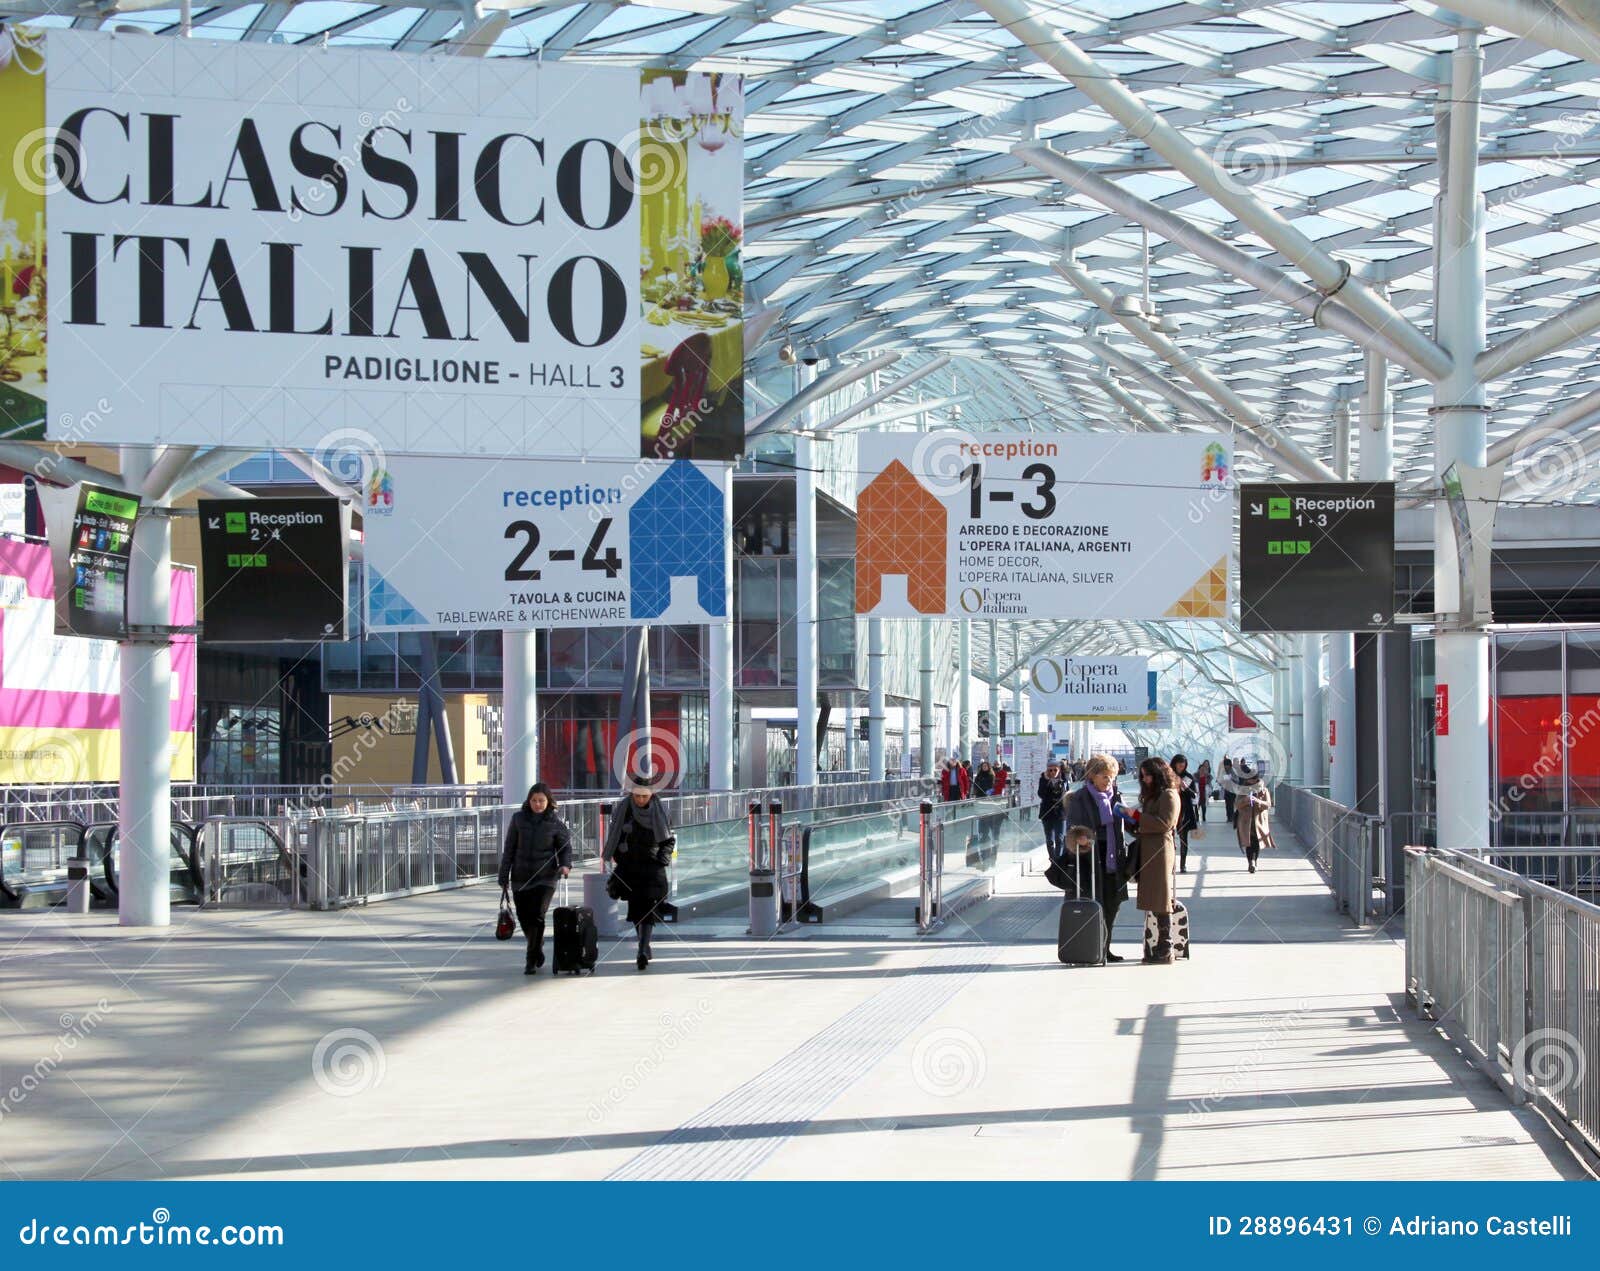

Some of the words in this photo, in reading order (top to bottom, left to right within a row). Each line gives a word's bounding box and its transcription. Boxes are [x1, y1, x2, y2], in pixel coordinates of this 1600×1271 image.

[54, 106, 635, 231] CLASSICO
[63, 231, 628, 348] ITALIANO
[324, 355, 500, 384] PADIGLIONE
[529, 365, 600, 388] HALL
[609, 366, 625, 389] 3
[960, 440, 1057, 460] reception
[503, 484, 621, 510] reception
[960, 463, 1057, 520] 1-3
[1295, 497, 1375, 513] Reception
[250, 512, 323, 526] Reception
[960, 526, 1009, 537] ARREDO
[1013, 526, 1021, 536] E
[1024, 525, 1109, 537] DECORAZIONE
[504, 518, 622, 581] 2-4
[960, 541, 1011, 552] L'OPERA
[1015, 541, 1074, 554] ITALIANA,
[1078, 541, 1131, 553] ARGENTI
[960, 556, 995, 567] HOME
[998, 556, 1043, 569] DECOR,
[960, 571, 1008, 583] L'OPERA
[1012, 572, 1069, 585] ITALIANA,
[1073, 572, 1114, 583] SILVER
[510, 593, 562, 605] TAVOLA
[564, 594, 573, 604] &
[577, 591, 626, 604] CUCINA
[437, 611, 514, 624] TABLEWARE
[518, 611, 527, 622] &
[532, 607, 626, 621] KITCHENWARE
[983, 600, 1028, 614] italiana
[1064, 677, 1128, 695] italiana
